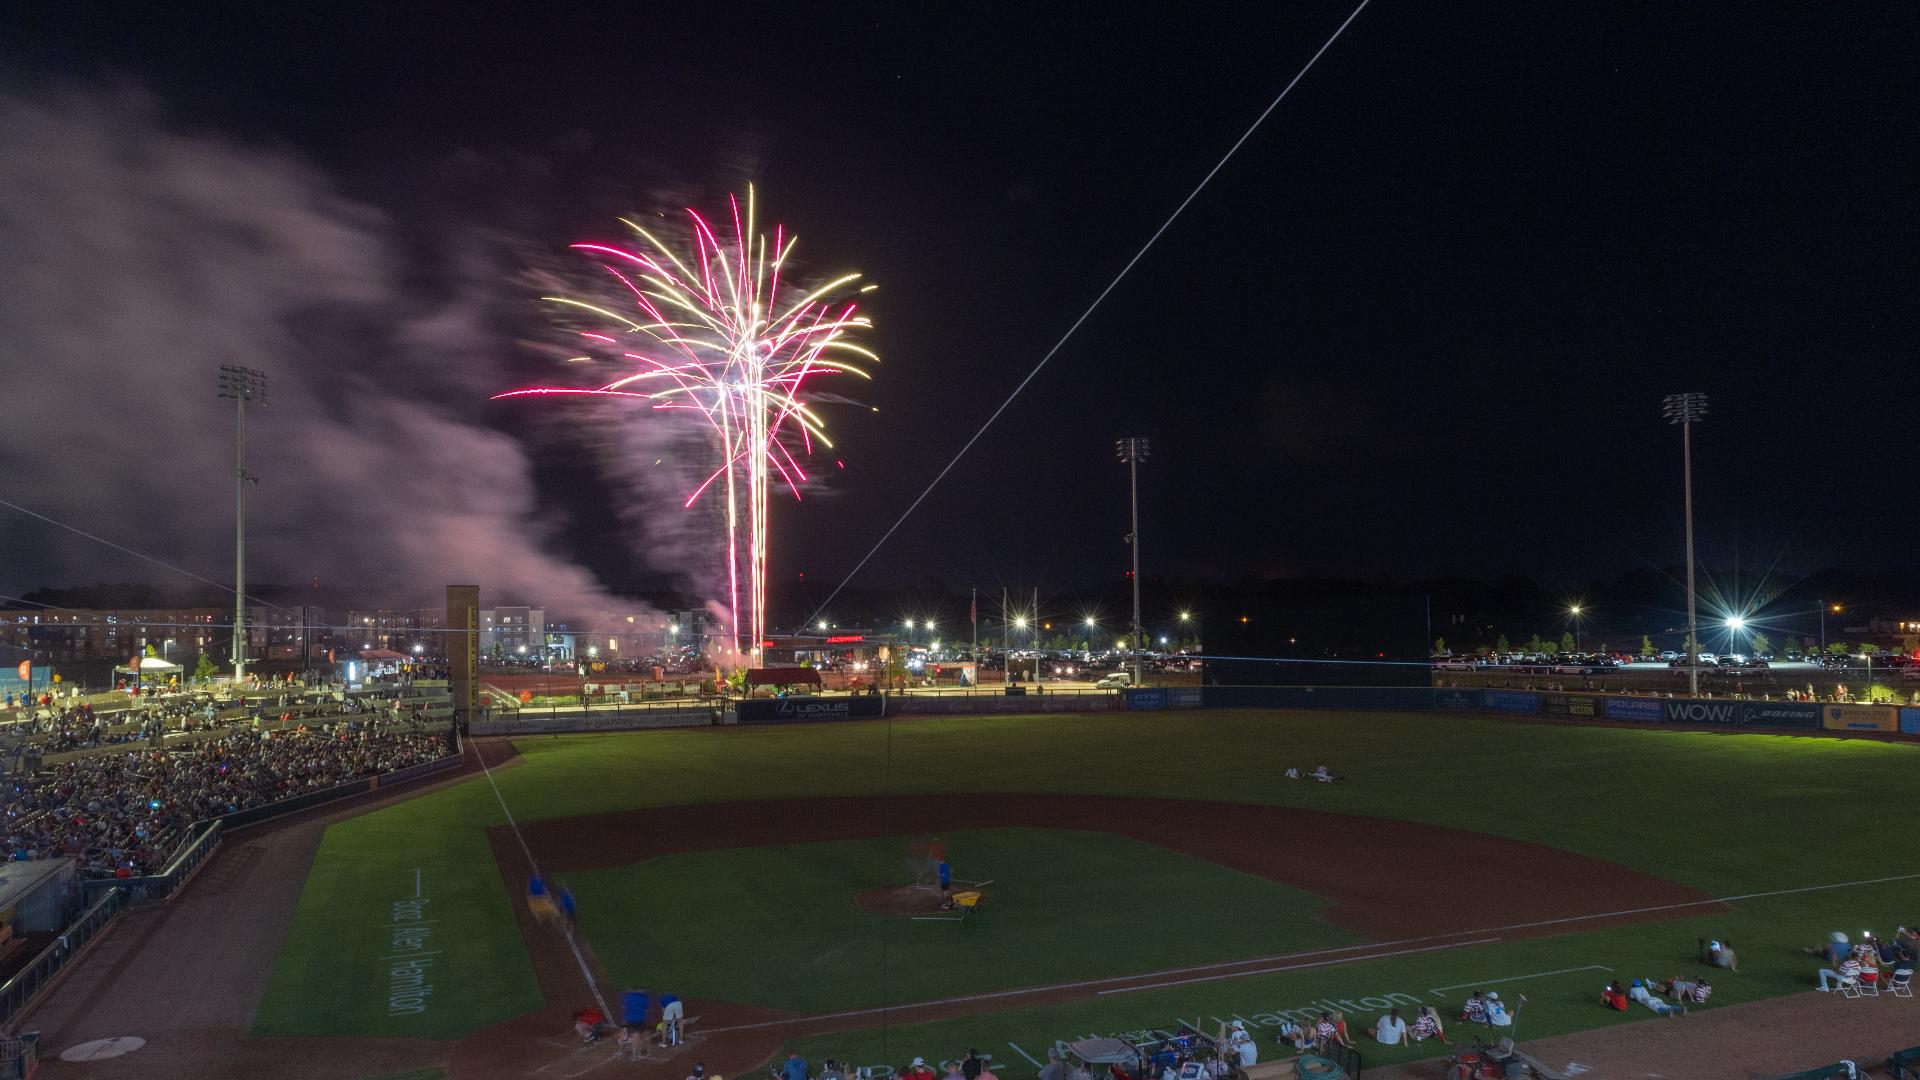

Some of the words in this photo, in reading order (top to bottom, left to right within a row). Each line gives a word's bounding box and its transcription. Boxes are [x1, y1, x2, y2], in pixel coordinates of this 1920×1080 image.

[796, 703, 849, 713] LEXUS
[1607, 699, 1659, 710] POLARIS
[1668, 703, 1734, 722] WOW!
[1760, 710, 1815, 719] BOEING
[389, 958, 434, 1017] Hamilton
[1211, 988, 1421, 1031] Hamilton
